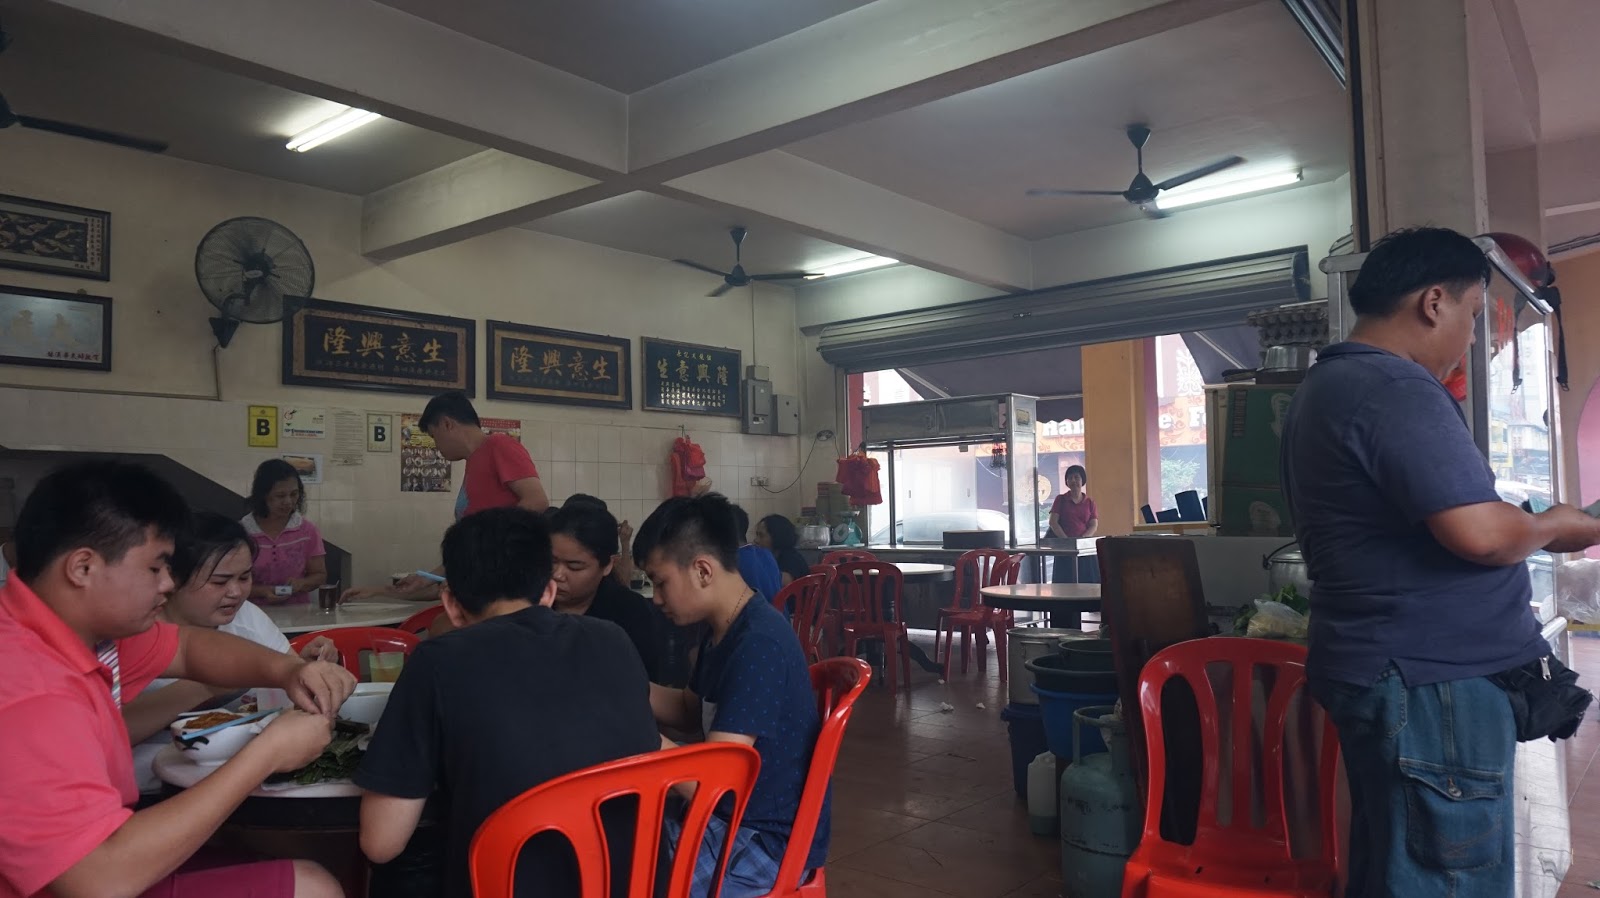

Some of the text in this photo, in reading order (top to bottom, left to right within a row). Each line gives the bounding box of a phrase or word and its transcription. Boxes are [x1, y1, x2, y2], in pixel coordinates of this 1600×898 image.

[1188, 405, 1206, 427] F
[256, 418, 271, 436] B
[374, 425, 386, 442] B
